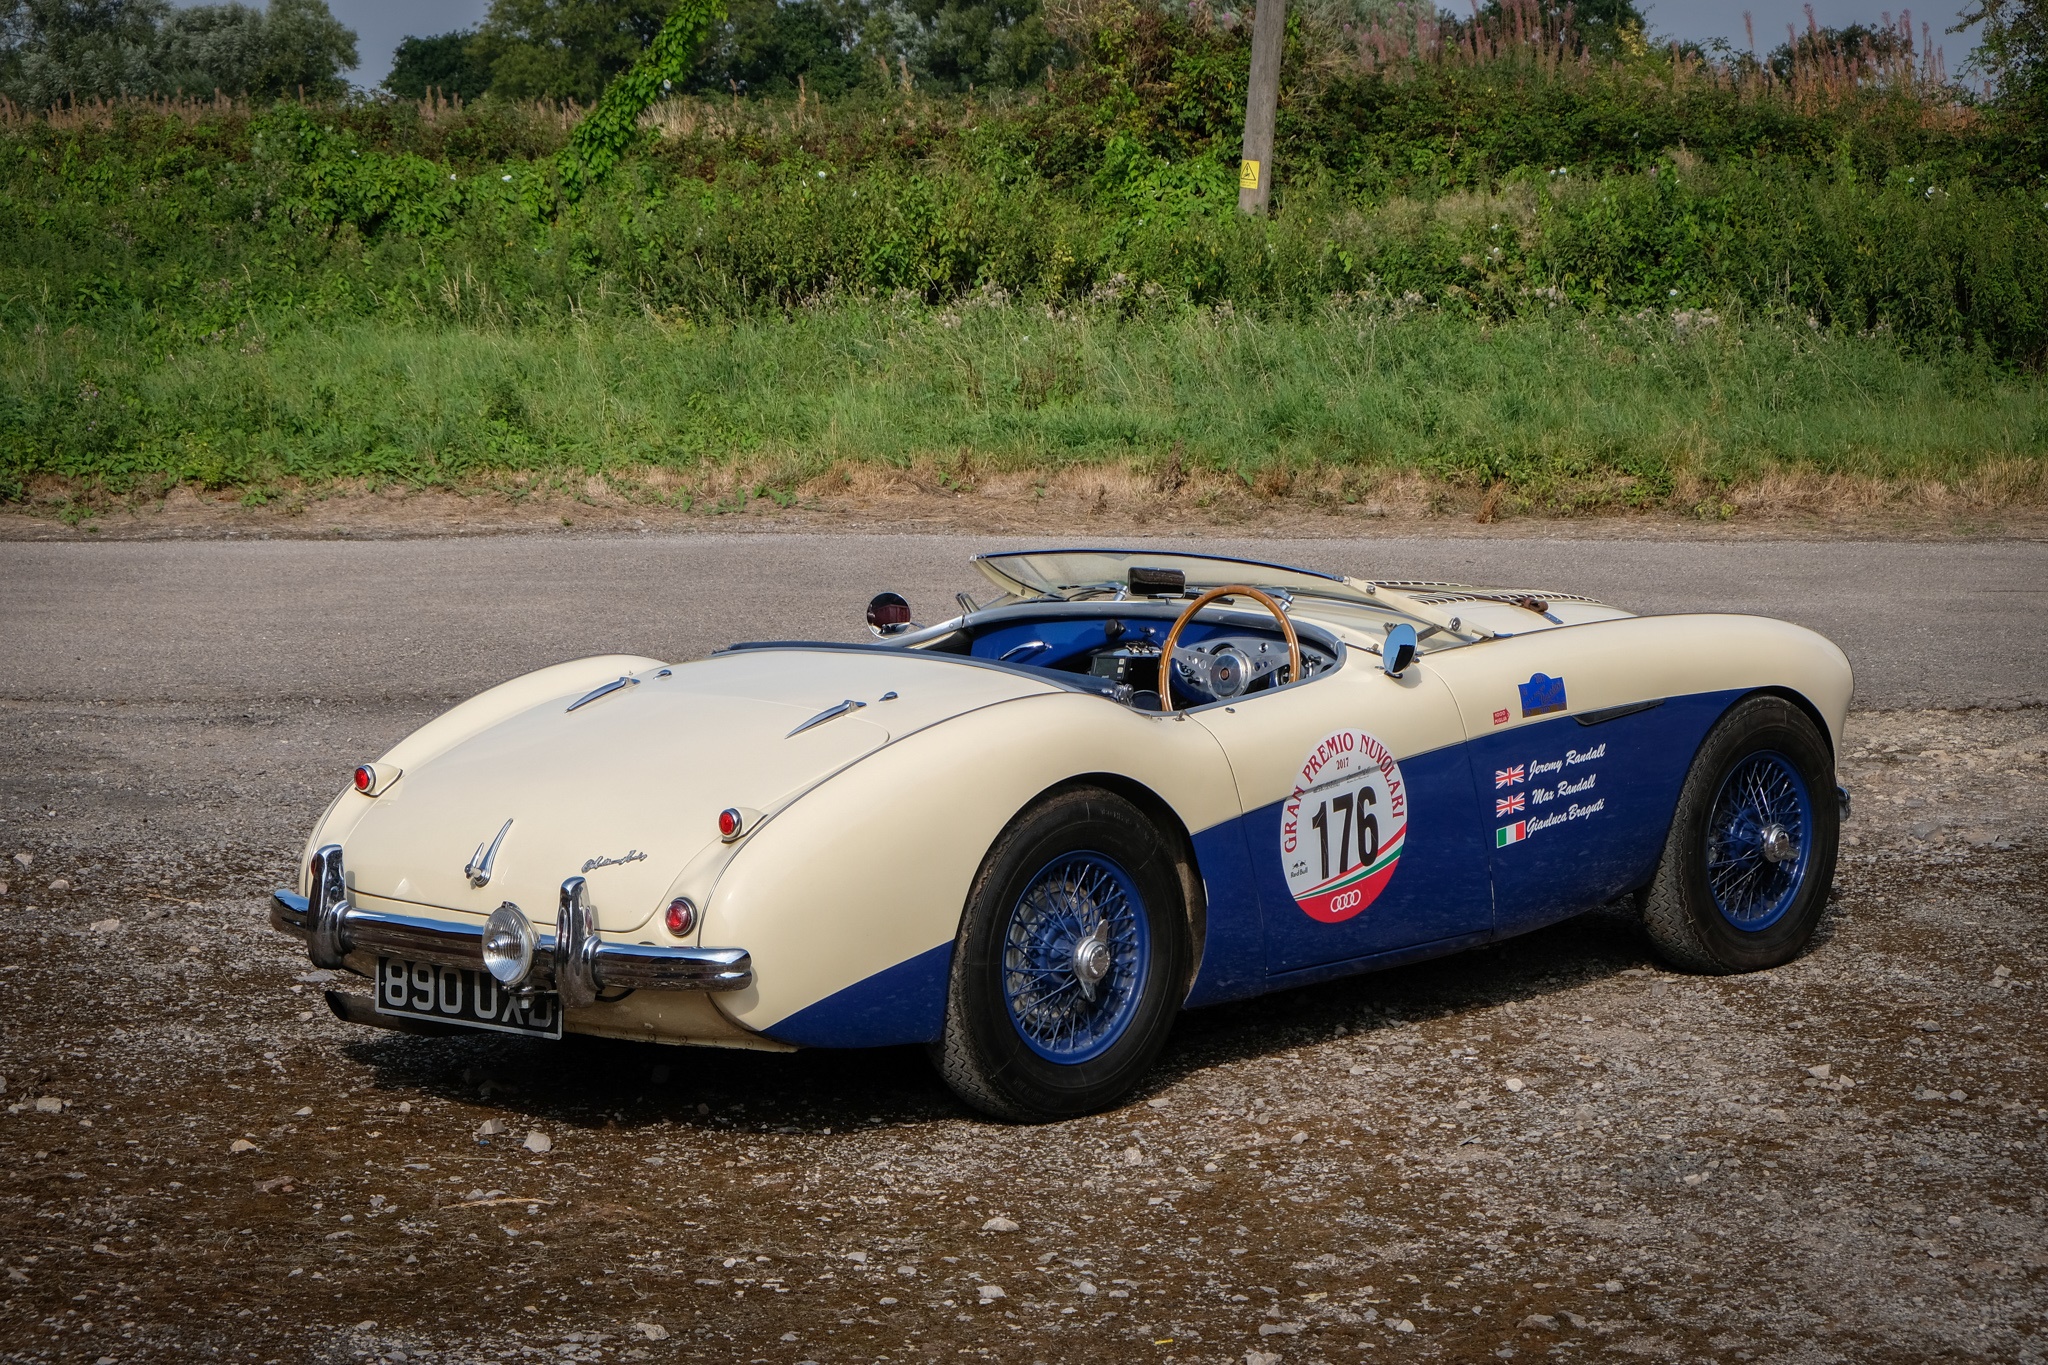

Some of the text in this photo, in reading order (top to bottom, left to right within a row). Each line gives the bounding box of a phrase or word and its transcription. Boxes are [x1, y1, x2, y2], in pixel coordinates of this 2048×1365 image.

[1335, 757, 1350, 770] 2017
[1528, 743, 1606, 781] Jeremy Randall
[1284, 732, 1405, 853] GRAN PREMIO NUVOLARI
[1532, 773, 1596, 805] Max Randall
[1311, 785, 1379, 880] 176
[1527, 812, 1568, 838] Gianluca
[1290, 866, 1308, 878] Red Bull
[385, 957, 463, 1014] 890
